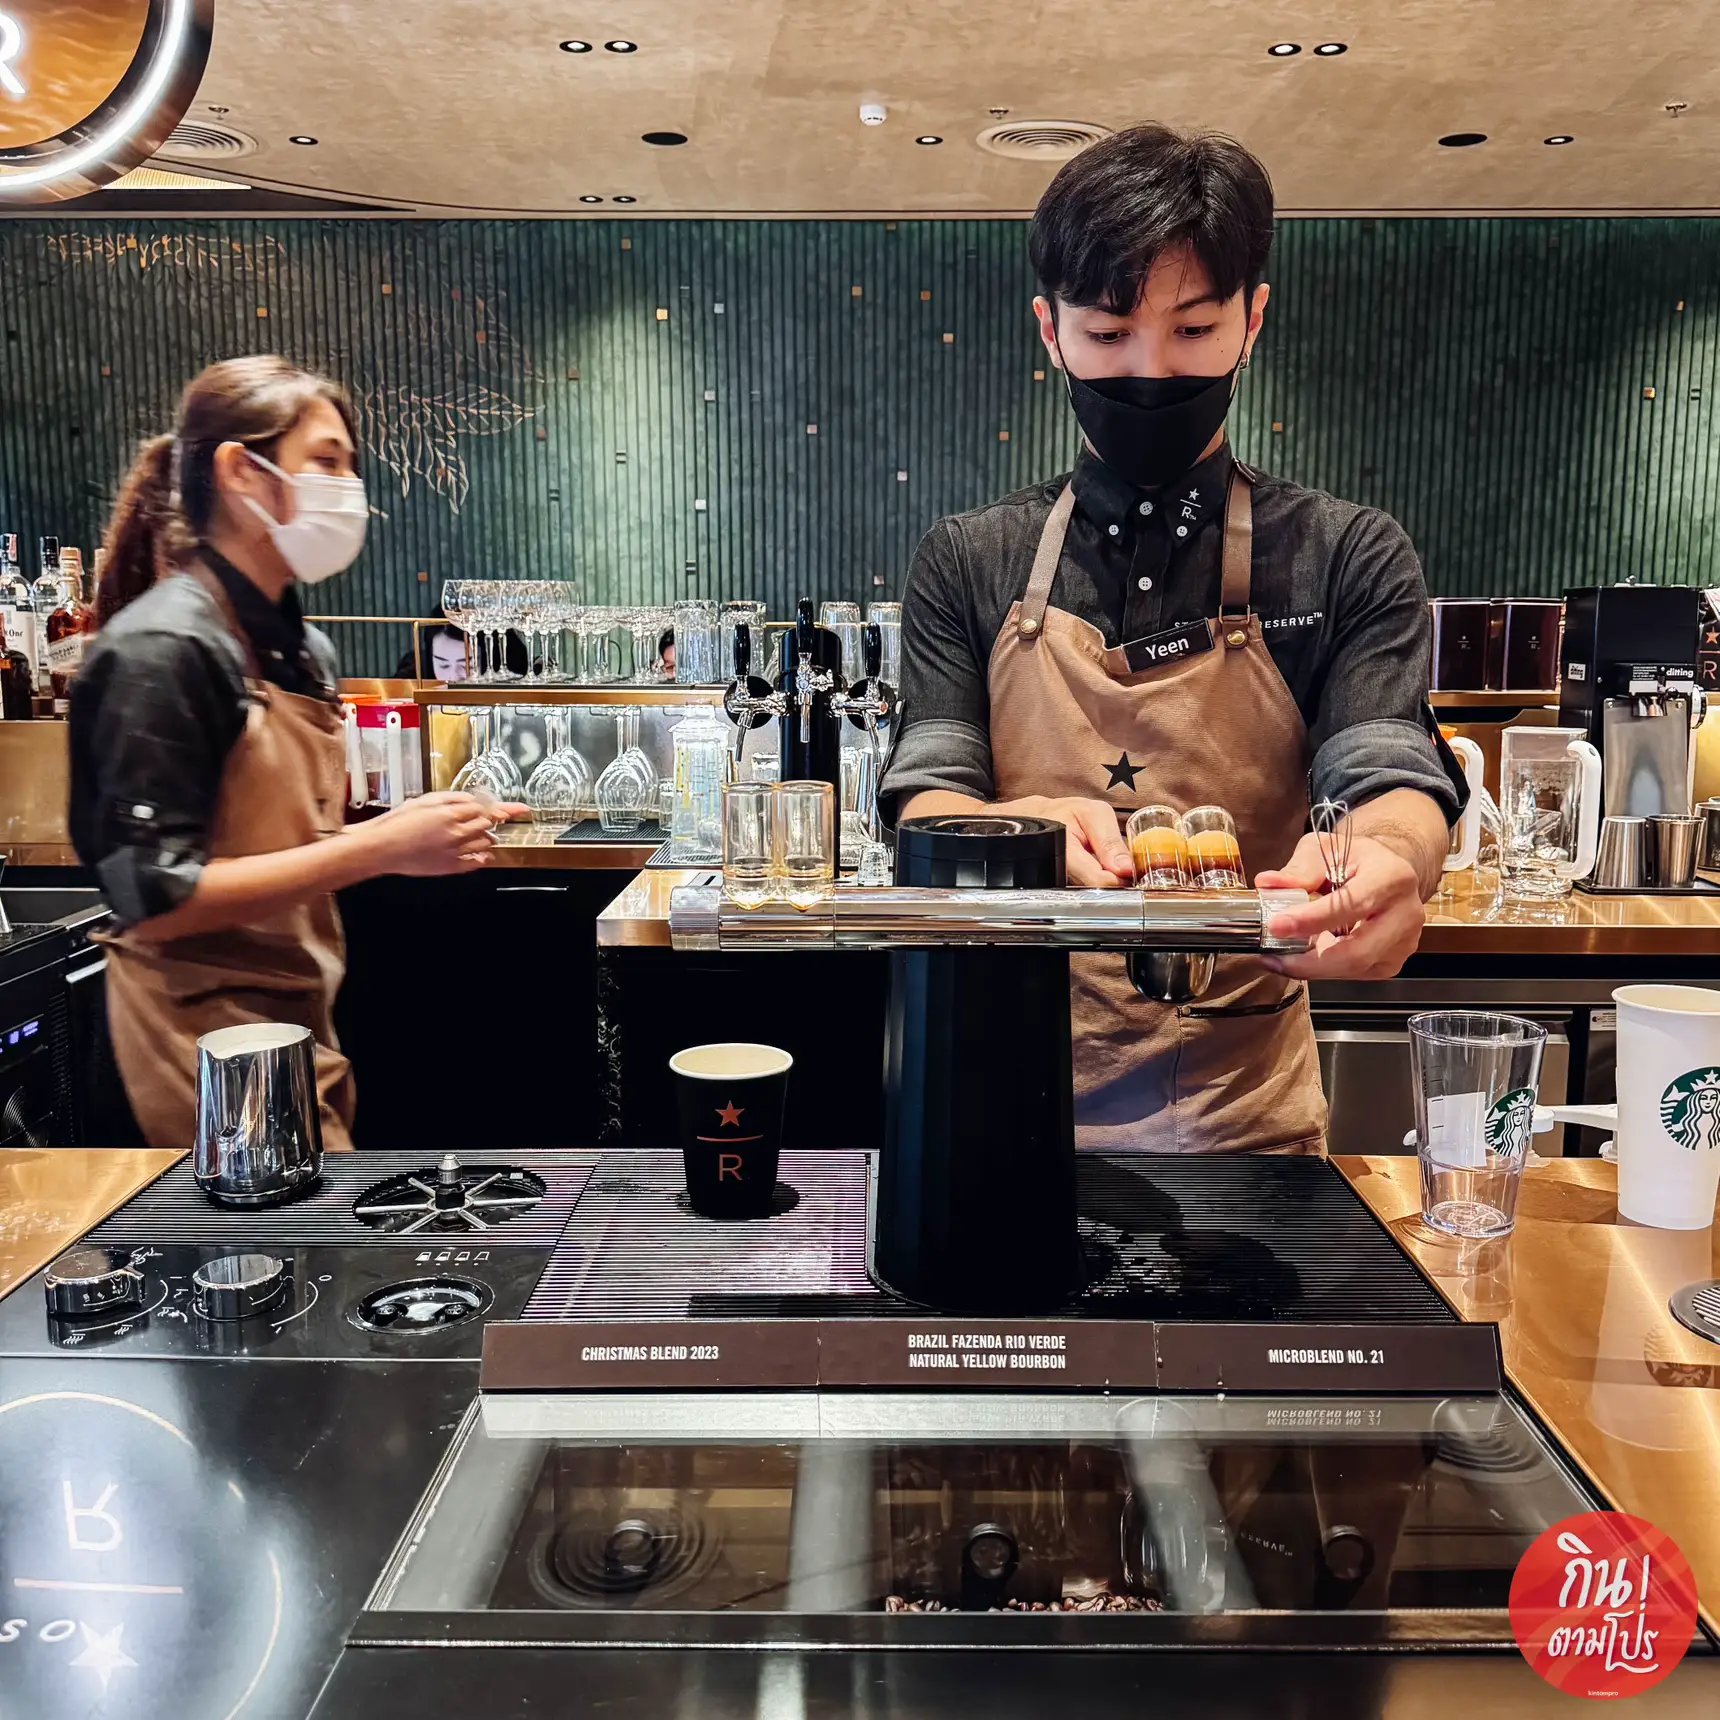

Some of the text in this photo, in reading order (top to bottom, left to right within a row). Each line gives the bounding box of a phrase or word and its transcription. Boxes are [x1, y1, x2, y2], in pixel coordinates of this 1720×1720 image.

[1145, 637, 1190, 660] Yeen
[1666, 668, 1694, 678] ditting
[1703, 661, 1717, 679] R
[719, 1154, 743, 1181] R
[908, 1334, 1067, 1349] BRAZIL FAZENDA RIO VERDE
[582, 1346, 719, 1360] CHRISTMAS BLEND 2023
[1268, 1349, 1385, 1364] MICROBLEND NO. 21
[909, 1354, 1067, 1369] NATURAL YELLOW BOURBON
